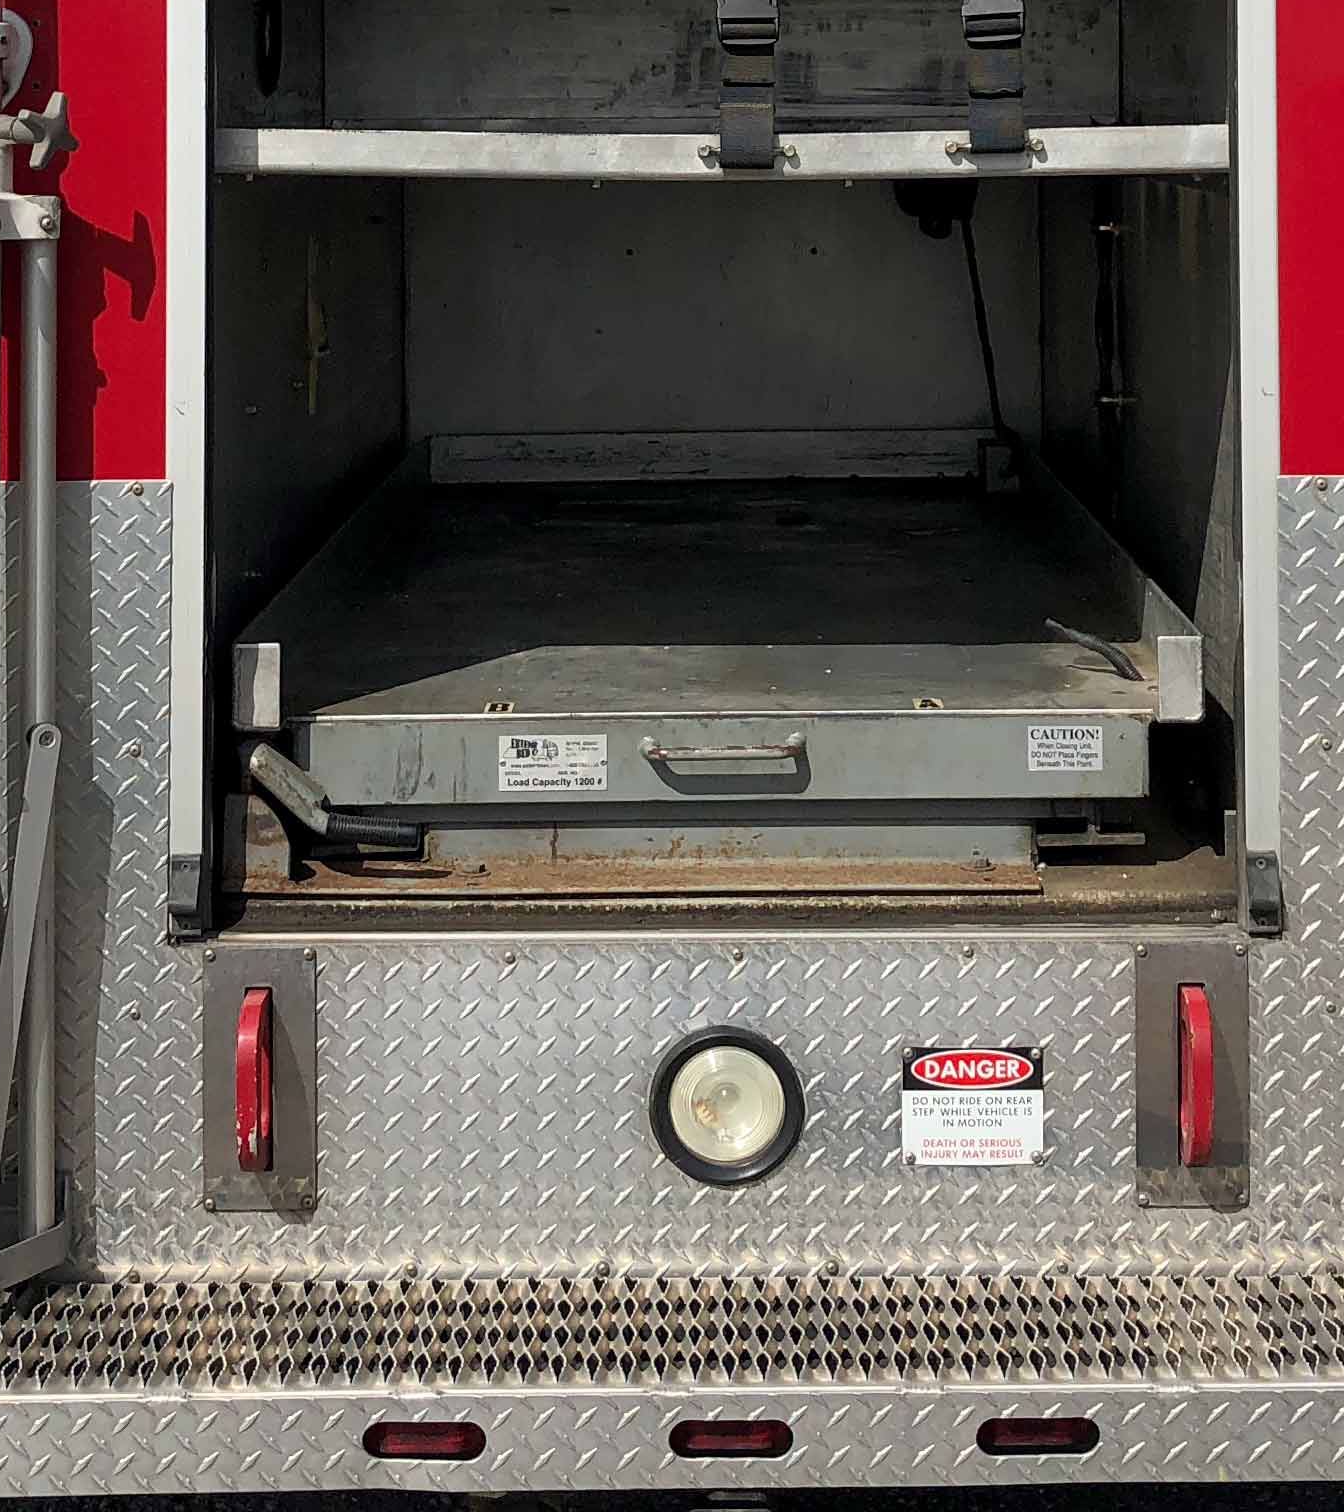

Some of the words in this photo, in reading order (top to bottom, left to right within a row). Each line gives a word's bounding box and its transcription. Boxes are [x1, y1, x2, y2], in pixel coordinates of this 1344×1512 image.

[1030, 729, 1100, 740] CAUTION!
[1076, 751, 1098, 759] Fingers
[507, 778, 529, 786] Load
[532, 778, 571, 787] Capacity
[575, 777, 595, 786] 1200
[924, 1059, 1021, 1079] DANGER
[912, 1096, 929, 1105] DO
[932, 1096, 955, 1105] NOT
[959, 1096, 982, 1105] RIDE
[985, 1096, 1003, 1105] ON
[1006, 1096, 1033, 1105] REAR
[912, 1107, 935, 1117] STEP
[941, 1107, 973, 1117] WHILE
[978, 1107, 1018, 1117] VEHICLE
[1023, 1107, 1033, 1117] IS
[942, 1119, 954, 1128] IN
[957, 1119, 1003, 1128] MOTION
[923, 1139, 956, 1148] DEATH
[960, 1139, 975, 1148] OR
[979, 1139, 1022, 1148] SERIOUS
[921, 1149, 958, 1159] INJURY
[962, 1149, 986, 1159] MAY
[990, 1149, 1024, 1159] RESULT
